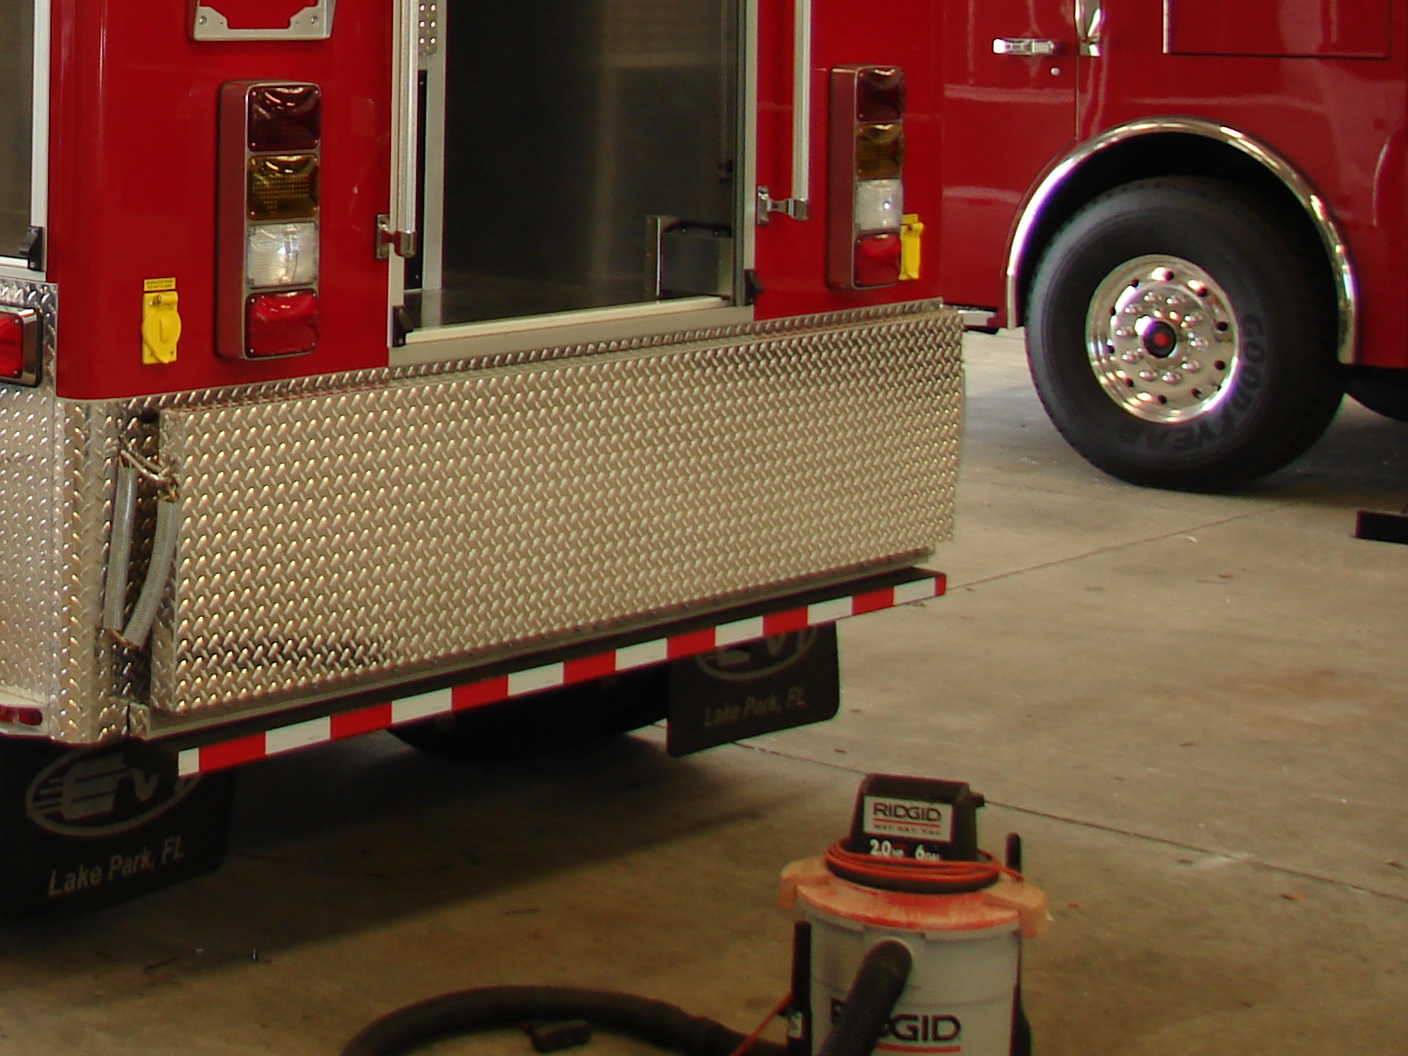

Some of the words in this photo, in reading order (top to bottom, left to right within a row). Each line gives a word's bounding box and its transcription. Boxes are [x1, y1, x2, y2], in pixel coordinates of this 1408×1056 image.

[704, 702, 740, 726] Lake
[872, 801, 942, 822] RIDGID
[48, 863, 102, 898] Lake
[108, 845, 155, 881] Park,
[161, 834, 186, 864] FL
